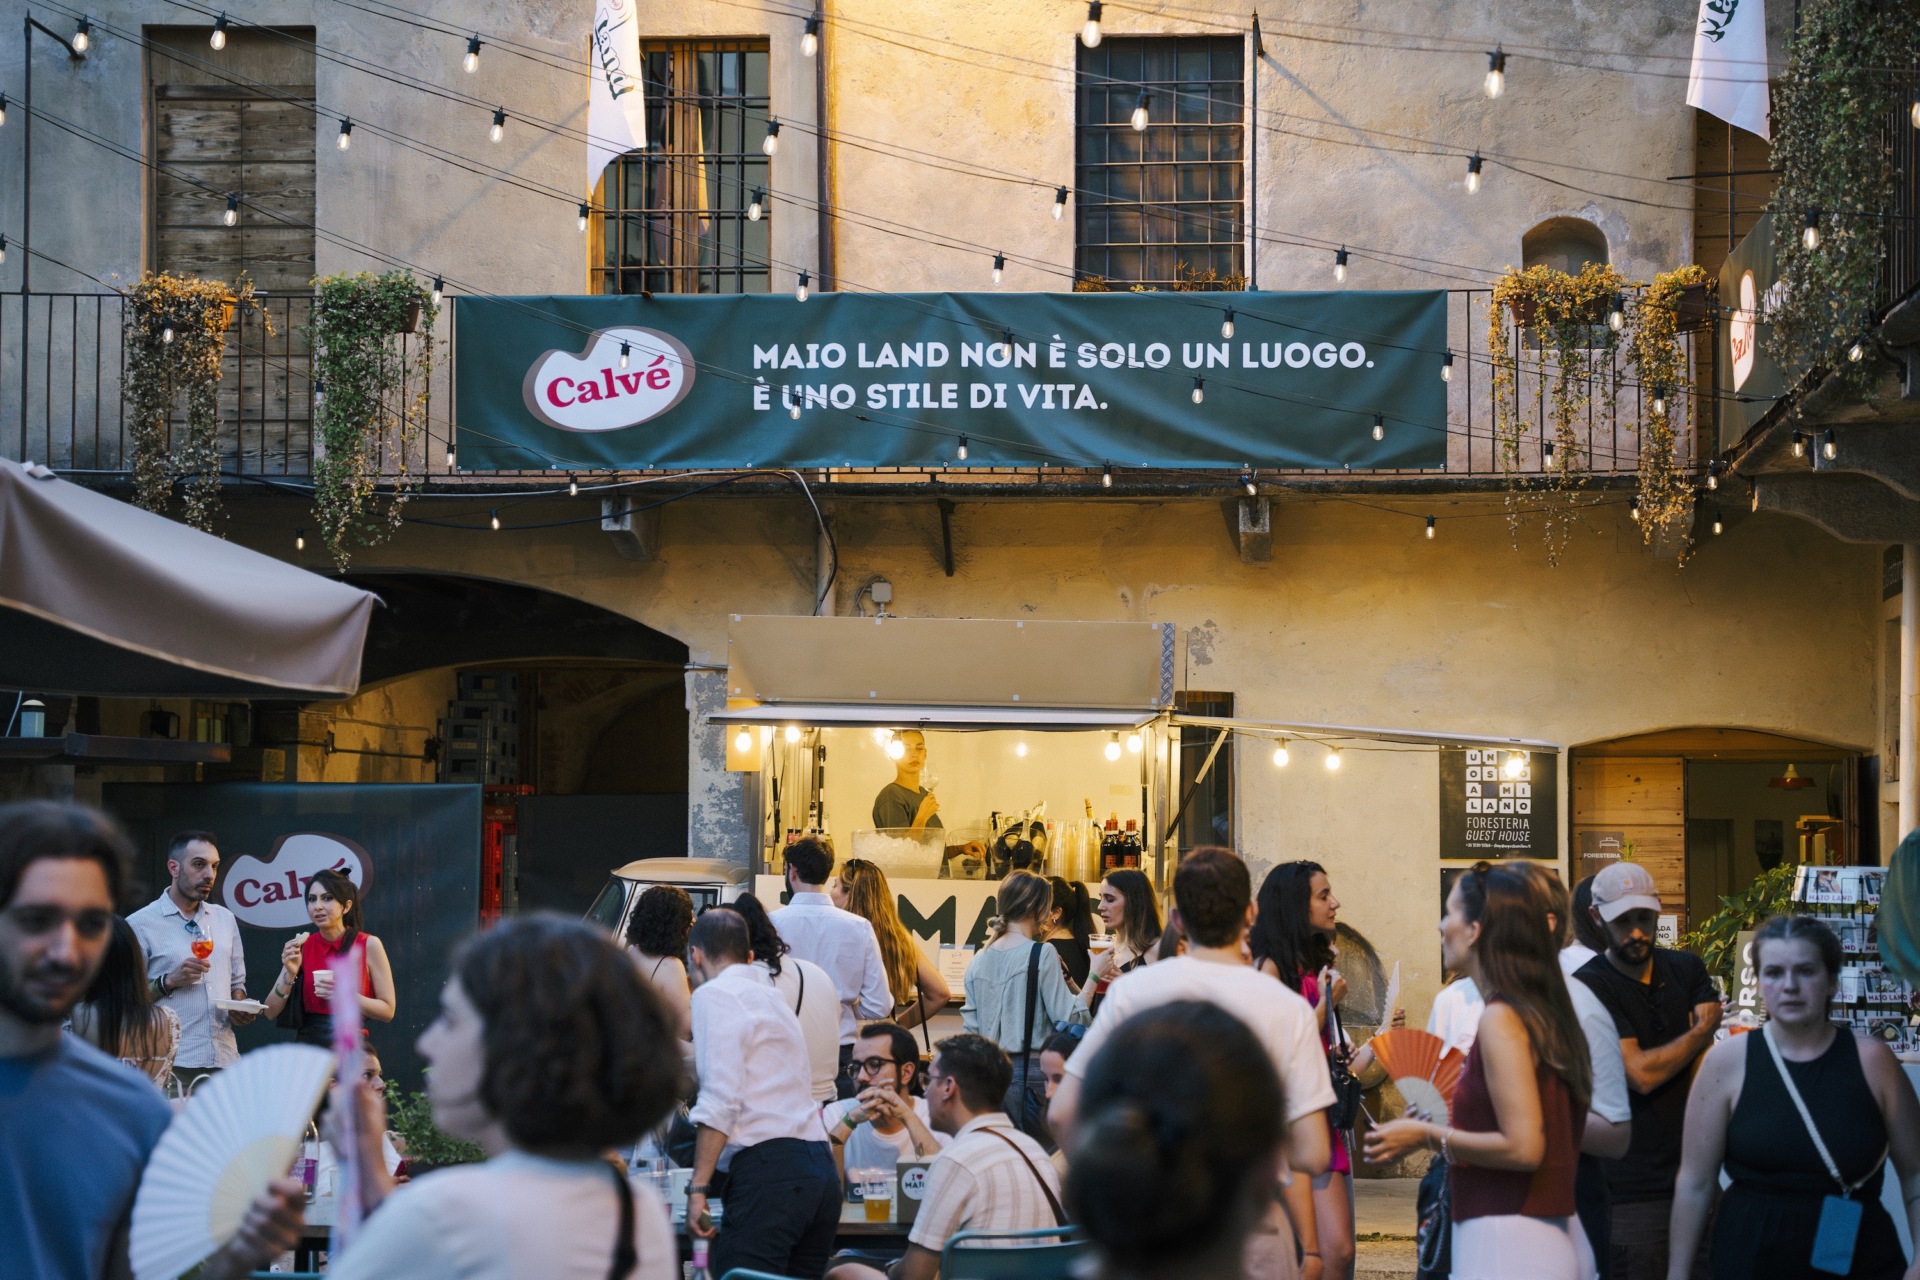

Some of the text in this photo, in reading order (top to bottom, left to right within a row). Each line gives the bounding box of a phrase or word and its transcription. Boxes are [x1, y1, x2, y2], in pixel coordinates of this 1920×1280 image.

[753, 333, 1375, 369] MAIO LAND NON È SOLO UN LUOGO.
[546, 354, 671, 408] Calvé
[753, 375, 1109, 410] È UNO STILE DI VITA.
[1465, 830, 1531, 842] GUEST HOUSE
[1466, 816, 1530, 830] FORESTERIA
